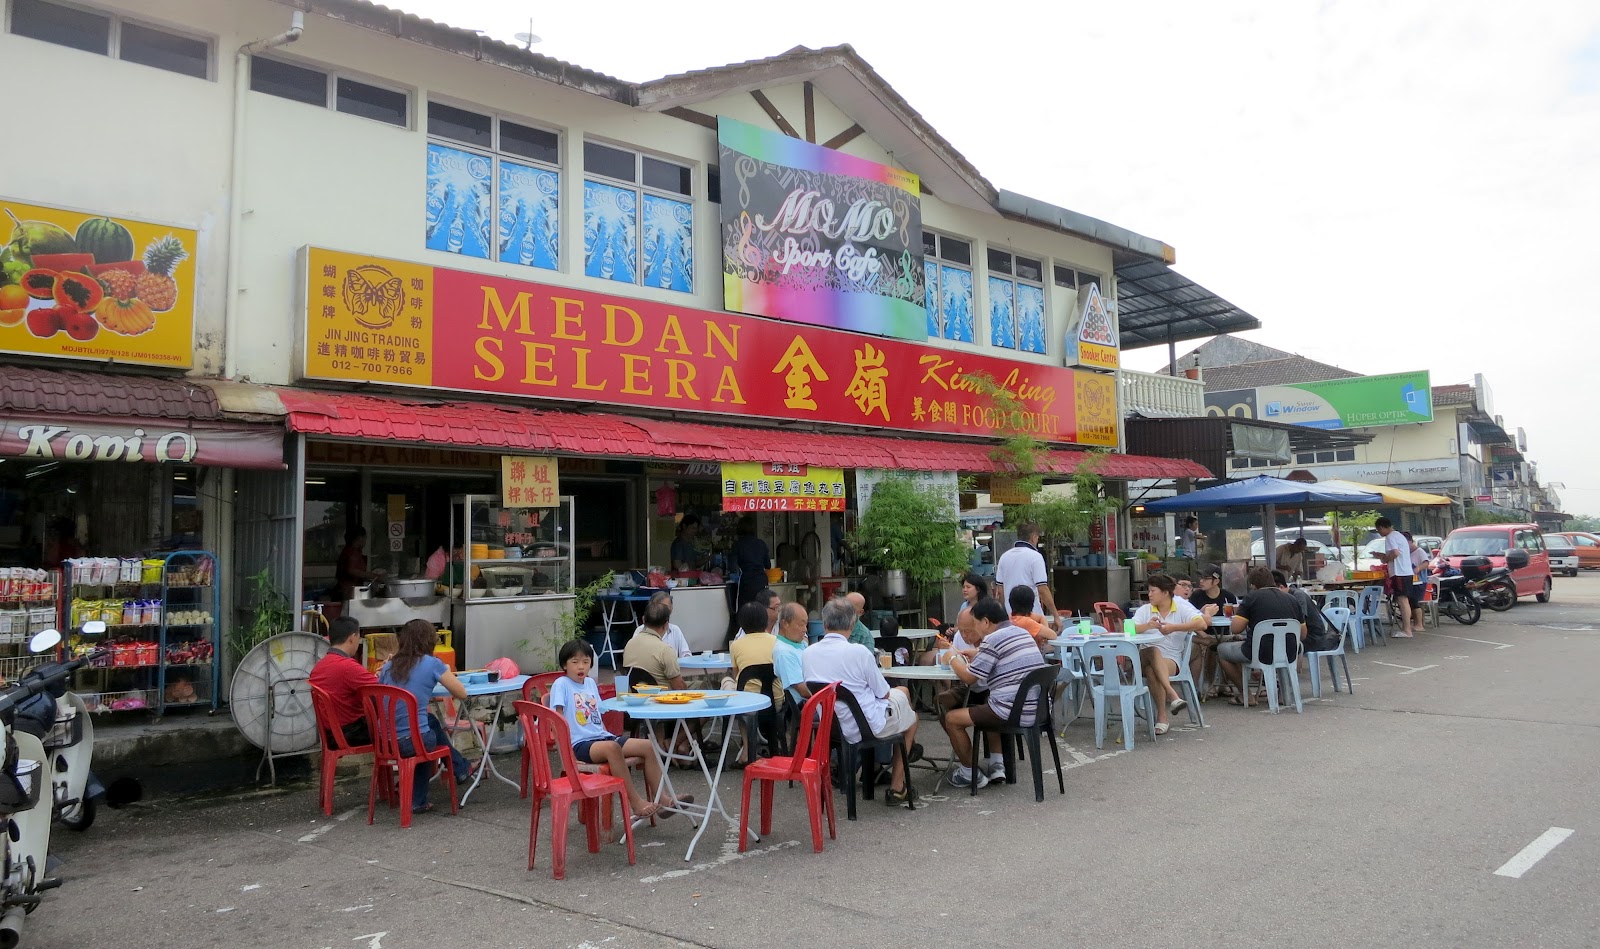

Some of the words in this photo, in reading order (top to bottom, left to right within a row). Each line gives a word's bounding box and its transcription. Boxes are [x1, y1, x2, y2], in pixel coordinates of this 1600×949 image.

[773, 237, 831, 275] Sport
[835, 244, 882, 281] Cafe
[322, 264, 337, 319] 蝴蝶牌
[410, 277, 424, 330] 咖啡粉
[477, 285, 743, 362] MEDAN
[317, 341, 426, 365] 進精咖啡粉貿易
[324, 328, 341, 341] JIN
[344, 331, 369, 344] JING
[371, 333, 420, 349] TRADING
[1080, 346, 1100, 362] Snooker
[1101, 349, 1117, 365] Centre
[385, 365, 413, 376] 7966
[473, 336, 747, 405] SELERA
[772, 334, 890, 422] 金嶺
[918, 354, 984, 395] Kim
[992, 367, 1057, 412] Ling
[911, 396, 957, 425] 美食閣
[962, 404, 1006, 430] FOOD
[1010, 411, 1060, 435] COURT
[1282, 404, 1320, 414] Window
[1378, 410, 1406, 419] OPTIK
[18, 425, 148, 462] Kopi
[510, 461, 551, 485] 聯姐
[744, 498, 787, 510] /6/2012
[794, 499, 840, 511] 开始营业
